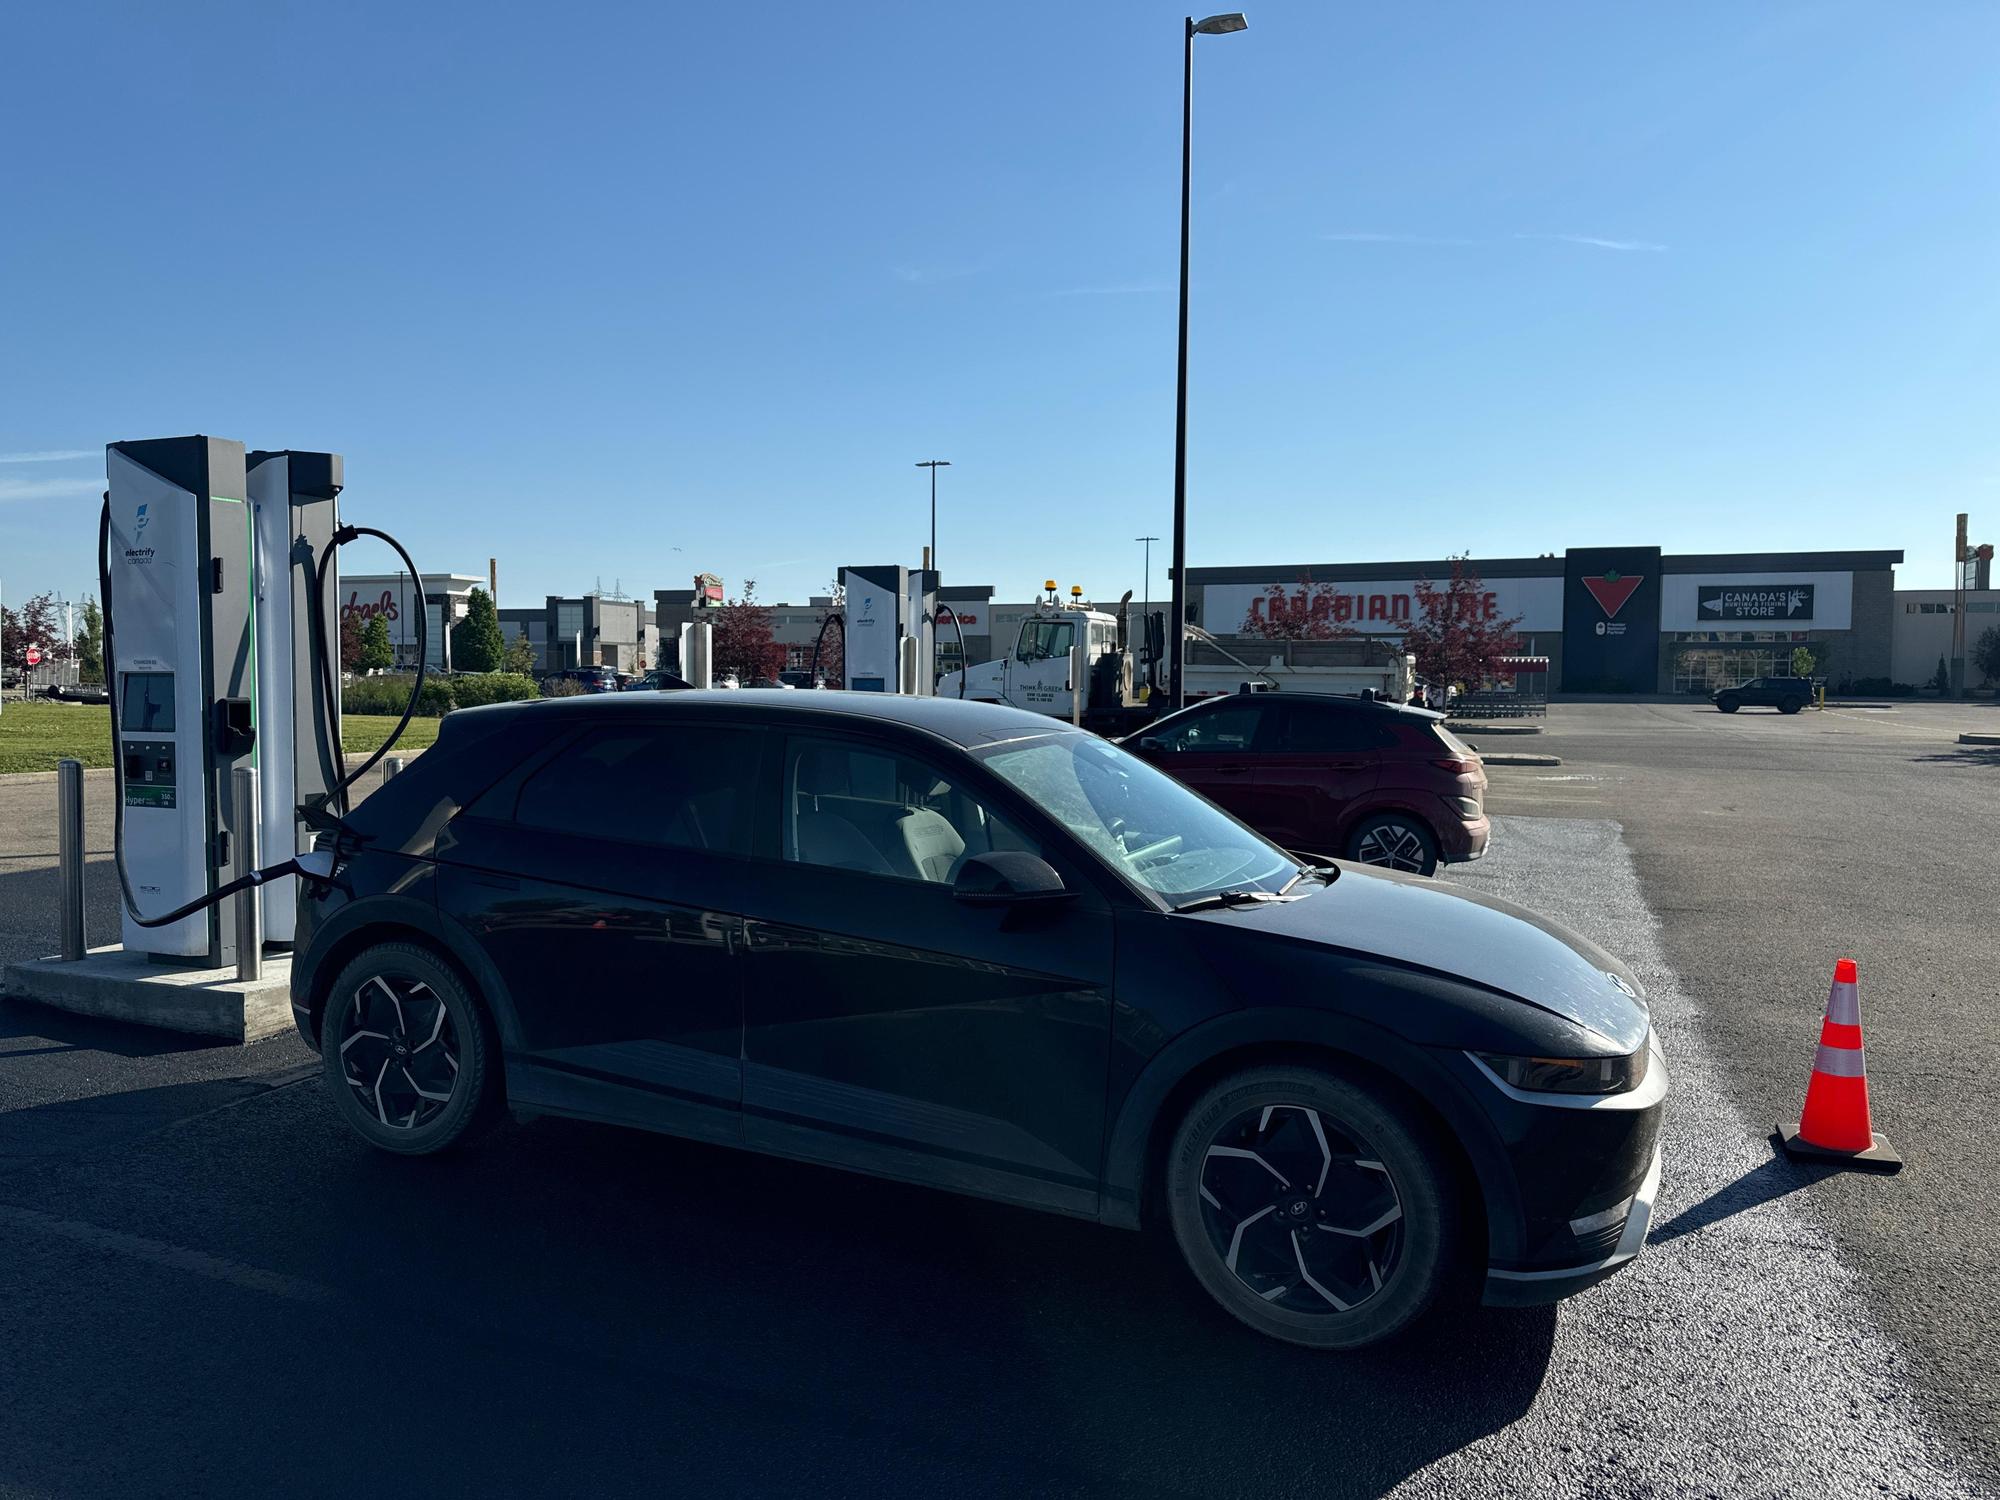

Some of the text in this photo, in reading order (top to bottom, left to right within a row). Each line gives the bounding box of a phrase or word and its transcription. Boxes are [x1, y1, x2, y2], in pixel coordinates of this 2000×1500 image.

[125, 547, 155, 557] electrify
[1725, 592, 1786, 601] CANADA'S
[1736, 606, 1775, 616] STORE
